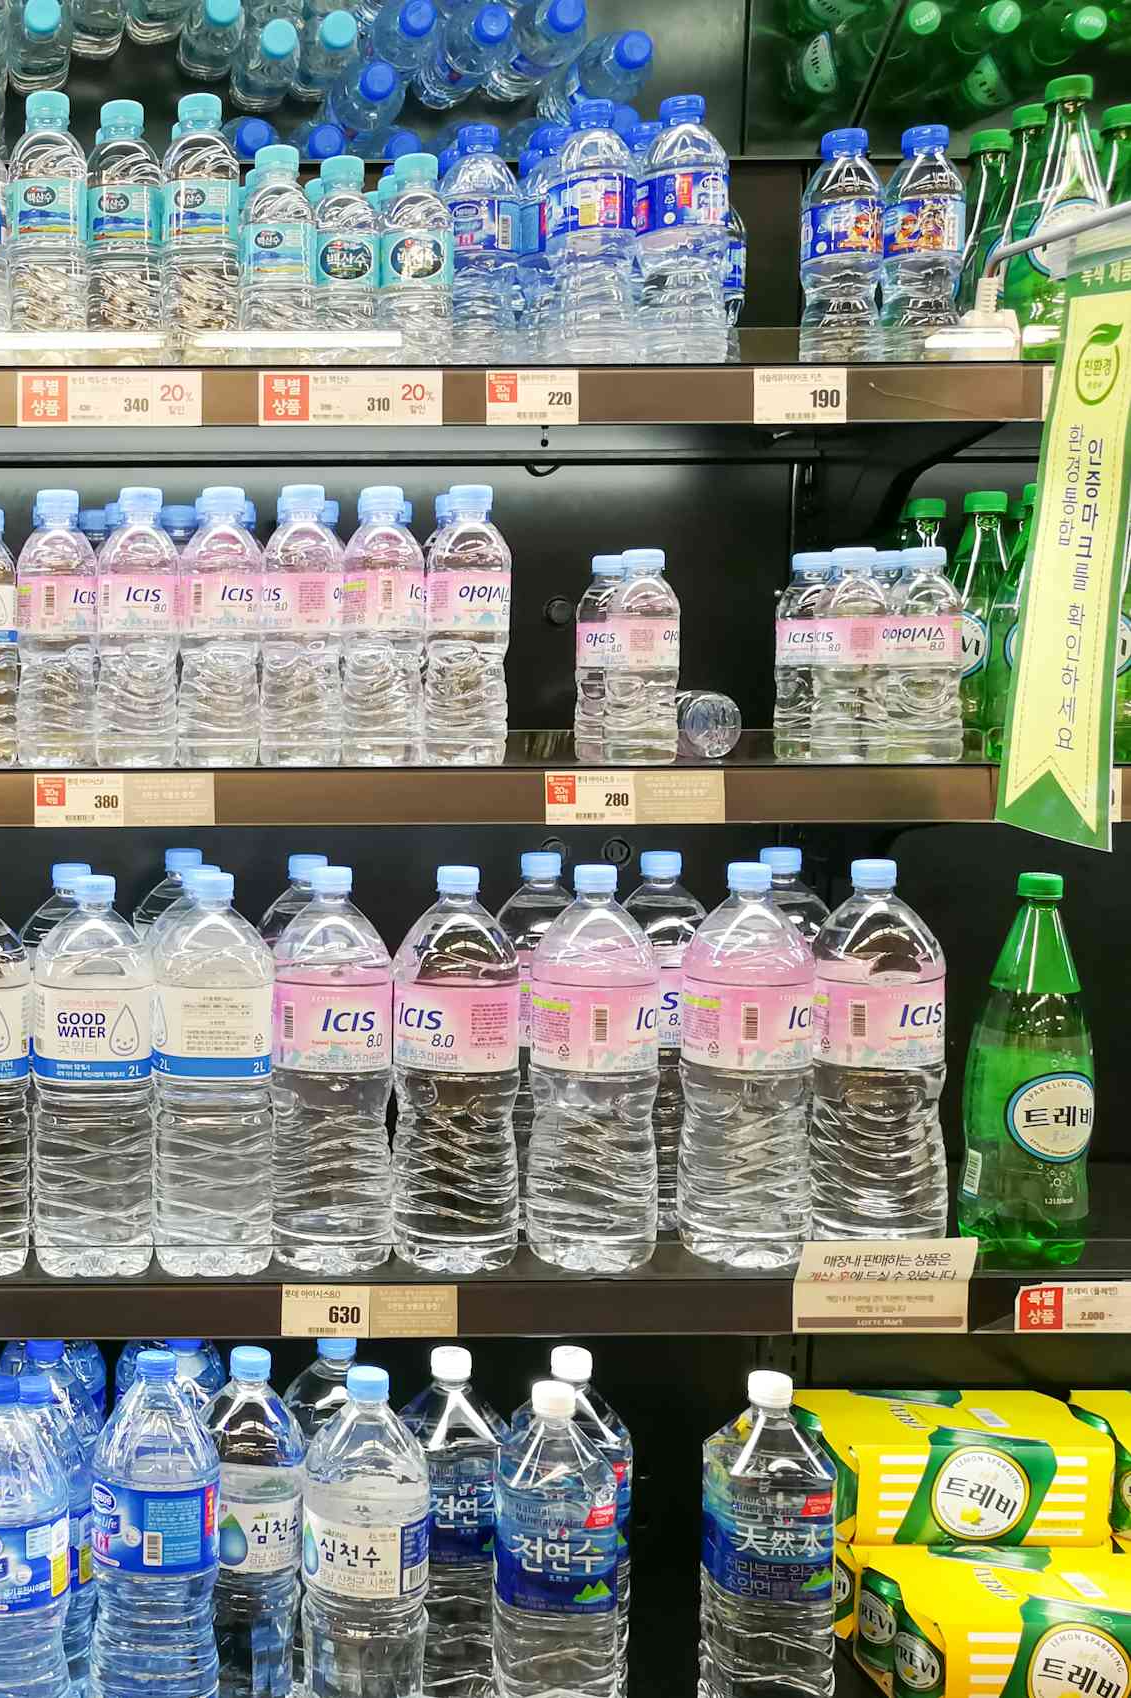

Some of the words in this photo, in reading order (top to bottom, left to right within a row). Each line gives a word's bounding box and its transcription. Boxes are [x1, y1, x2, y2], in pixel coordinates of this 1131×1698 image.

[325, 252, 368, 268] 백산수
[1084, 357, 1111, 377] 친환경
[30, 379, 60, 397] 특별
[271, 378, 301, 396] 특별
[124, 398, 149, 412] 340
[272, 398, 301, 416] 상품
[367, 397, 390, 411] 310
[548, 391, 572, 405] 220
[809, 389, 840, 408] 190
[30, 399, 61, 417] 상품
[1073, 437, 1103, 591] 인증마크를
[125, 586, 162, 602] ICIS
[221, 585, 254, 602] ICIS
[1055, 603, 1086, 750] 확인하세요
[94, 795, 118, 809] 380
[604, 792, 629, 807] 280
[57, 1012, 106, 1026] GOOD
[321, 1008, 375, 1032] ICIS
[398, 1002, 443, 1030] ICIS
[57, 1026, 106, 1039] WATER
[366, 1033, 383, 1047] 8.0
[431, 1033, 454, 1048] 8.0
[128, 1065, 142, 1077] 2L
[253, 1061, 266, 1073] 2L
[1024, 1081, 1075, 1102] SPARKLING
[1022, 1106, 1092, 1128] 트레비
[823, 1256, 860, 1268] 매장내
[862, 1254, 913, 1267] 판매하는
[915, 1252, 952, 1266] 상품은
[1027, 1290, 1056, 1306] 특별
[328, 1306, 361, 1324] 630
[1028, 1308, 1056, 1325] 상품
[941, 1477, 1018, 1520] 트레비
[250, 1515, 300, 1545] 심천수
[735, 1521, 826, 1558] 天然水
[320, 1538, 381, 1569] 심천수
[511, 1534, 605, 1574] 천연수
[859, 1604, 893, 1635] REVI
[899, 1645, 936, 1679] REVI
[1037, 1657, 1122, 1698] 트레비
